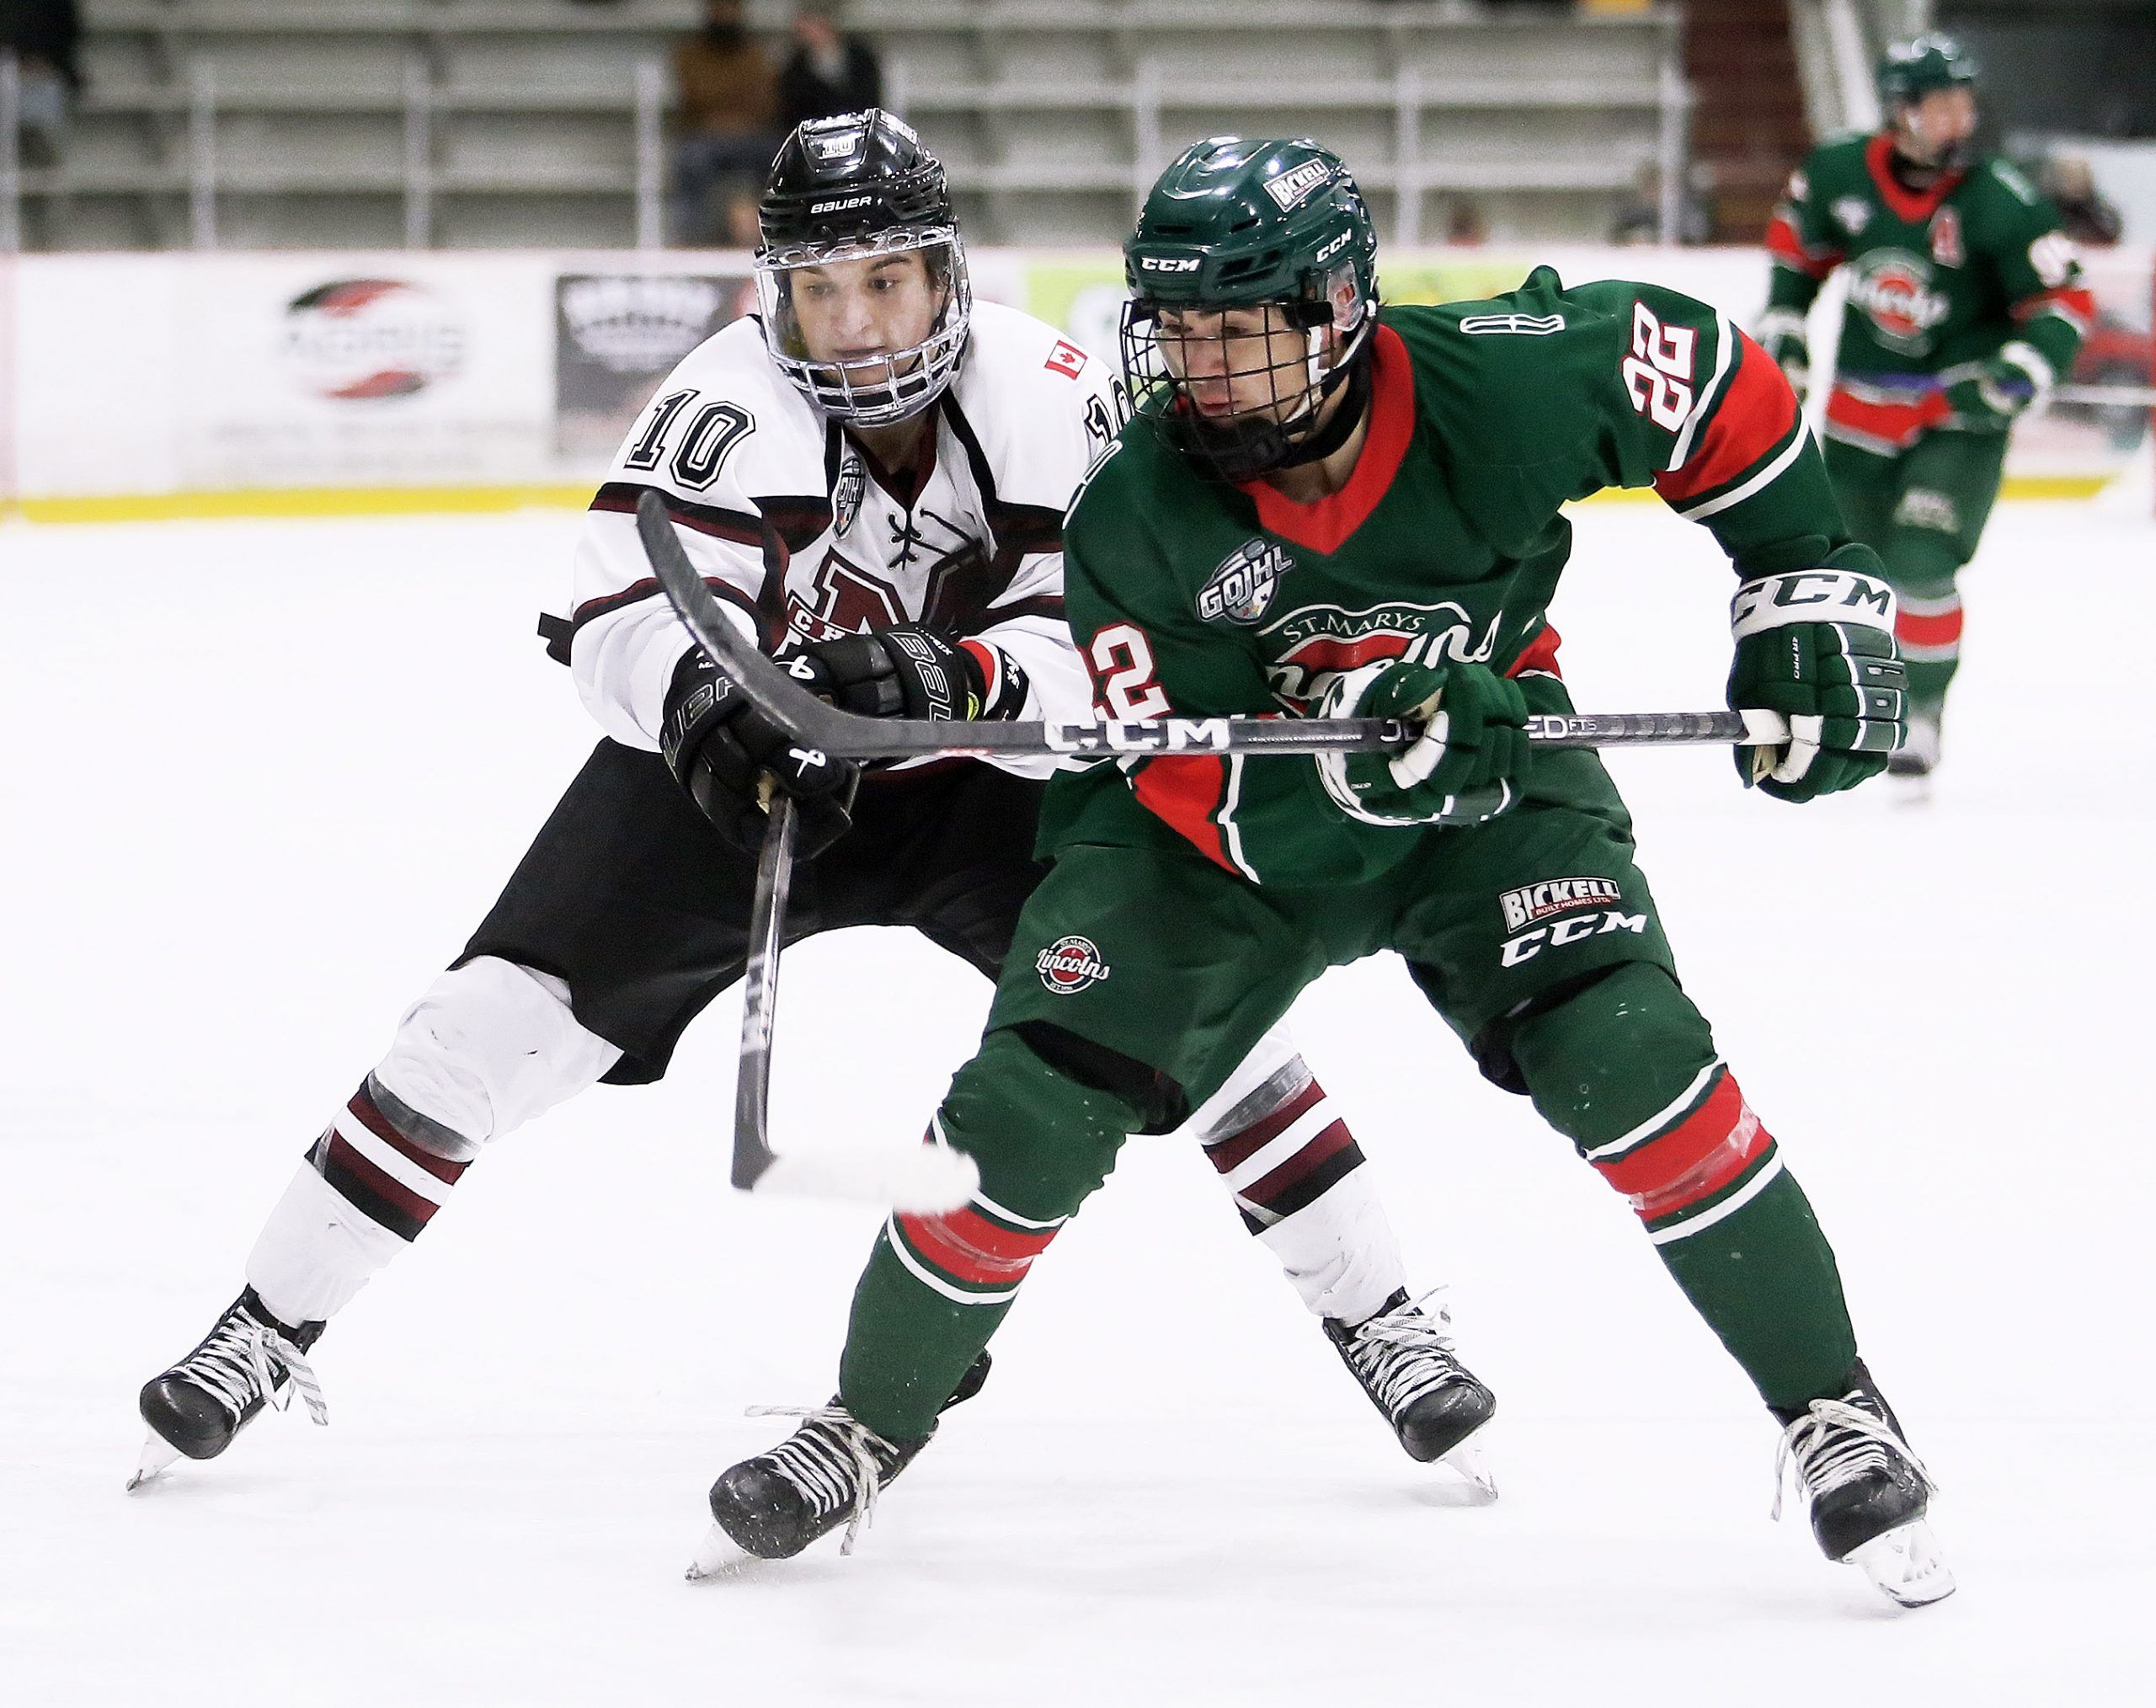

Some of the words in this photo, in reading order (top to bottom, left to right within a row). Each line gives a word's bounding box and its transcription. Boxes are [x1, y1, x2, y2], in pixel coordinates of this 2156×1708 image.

[1141, 257, 1201, 272] CCM
[1316, 228, 1352, 263] CCM
[1621, 299, 1697, 433] 22
[624, 389, 755, 492] 10
[1199, 546, 1293, 619] GOJHL
[1044, 718, 1230, 751] CCM
[1503, 880, 1620, 930] BICKELL
[1535, 904, 1560, 915] BUILT
[1500, 911, 1647, 968] CCM
[1035, 948, 1110, 980] Lincolns
